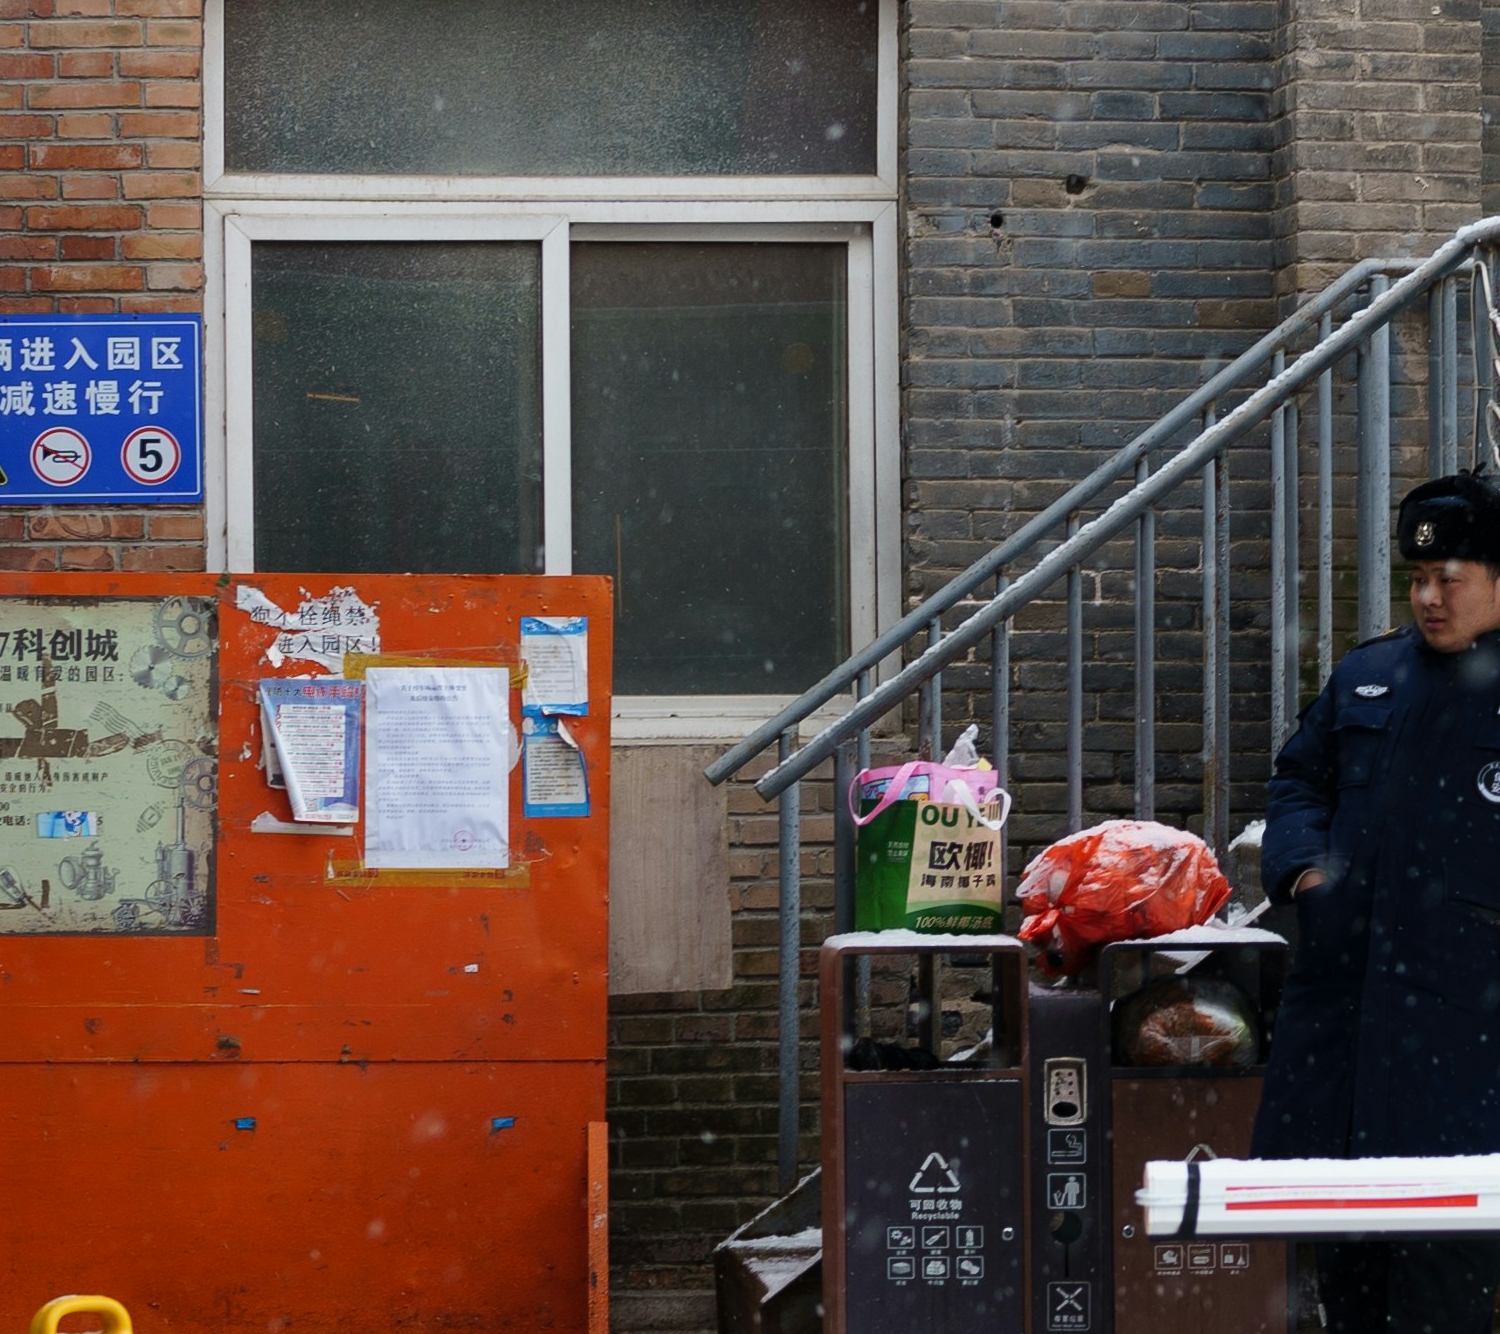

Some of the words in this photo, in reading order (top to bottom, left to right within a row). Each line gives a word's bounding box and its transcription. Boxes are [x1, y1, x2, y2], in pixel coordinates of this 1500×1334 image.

[139, 438, 163, 473] 5
[921, 804, 959, 828] OU
[909, 1199, 962, 1211] 可回收物
[911, 1211, 960, 1222] Recyclable
